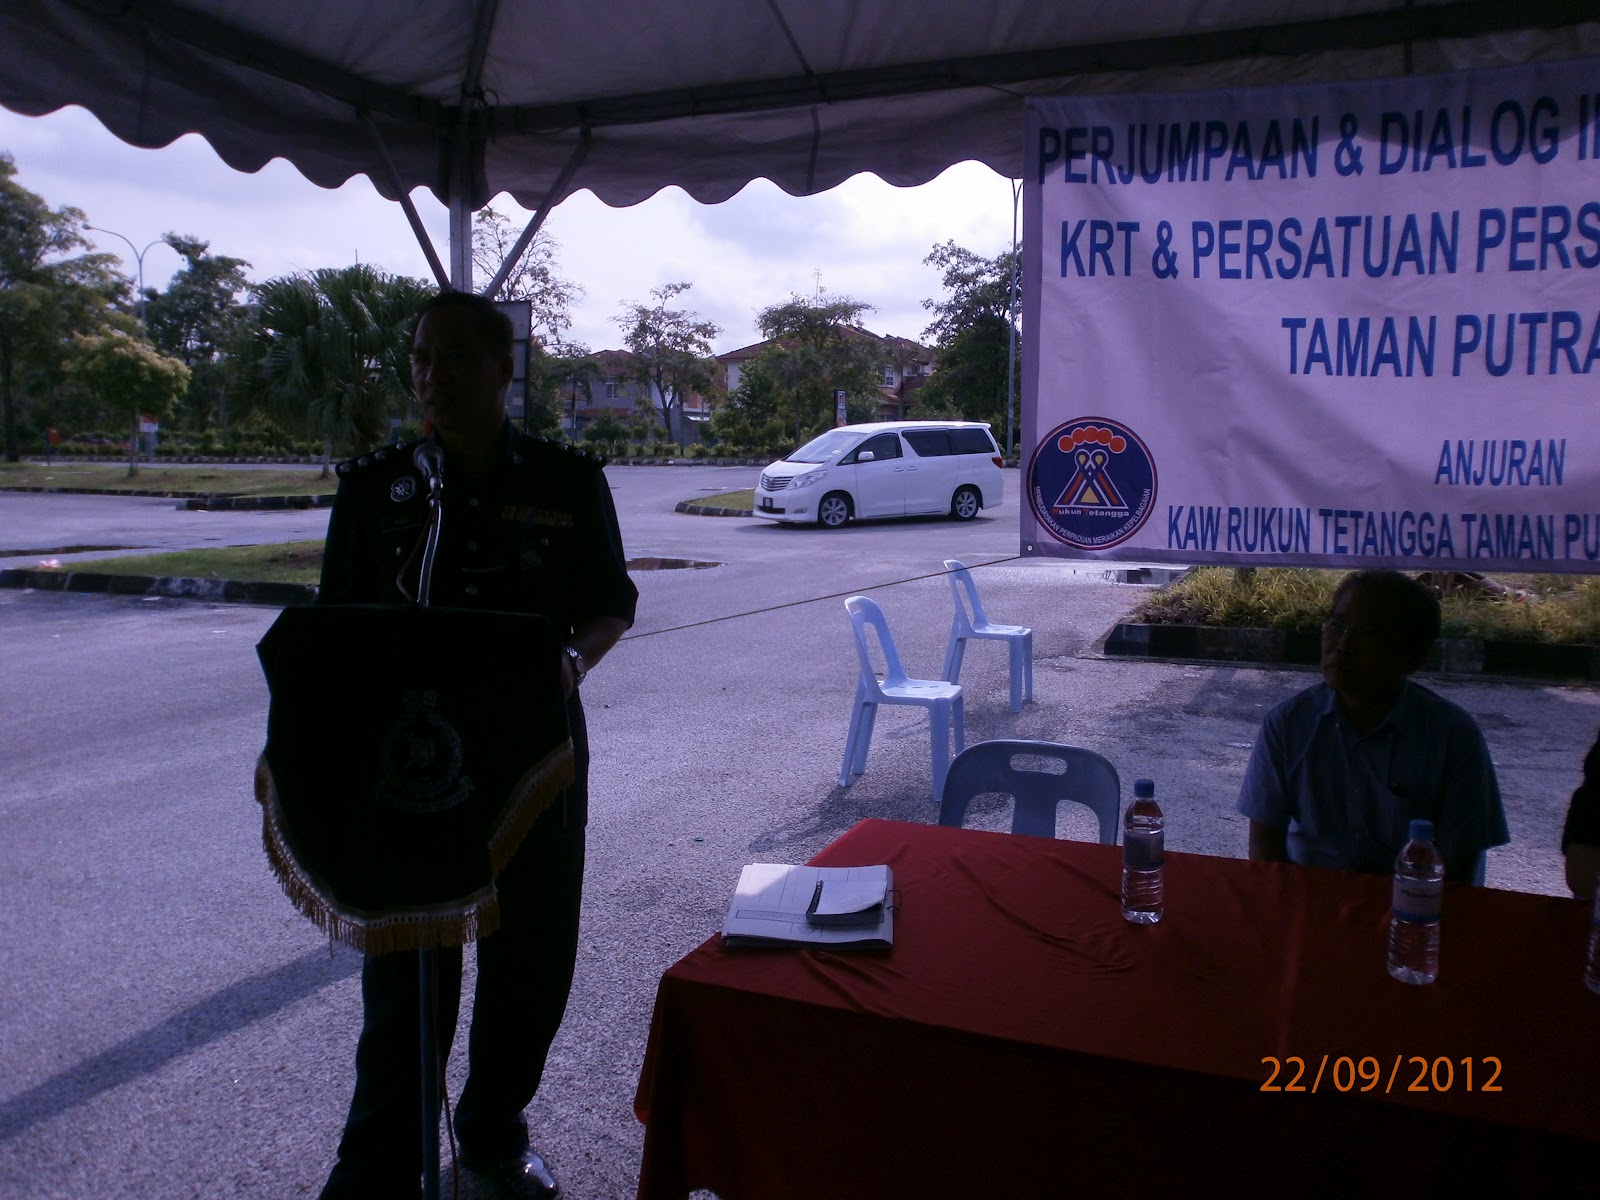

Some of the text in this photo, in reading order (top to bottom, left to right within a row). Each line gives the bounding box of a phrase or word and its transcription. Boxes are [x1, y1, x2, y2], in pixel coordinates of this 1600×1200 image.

[1038, 114, 1320, 185] PERJUMPAAN
[1334, 112, 1364, 177] &
[1379, 96, 1560, 174] DIALOG
[1061, 202, 1600, 280] KRT & PERSATUAN PERS
[1281, 315, 1437, 377] TAMAN
[1434, 439, 1567, 486] ANJURAN
[1034, 486, 1151, 544] MEMBUDAYAKAN PERPADUAN MERAIKAN KEPELBAGAIAN
[1085, 508, 1130, 518] Tetangga
[1168, 505, 1222, 551] KAW
[1227, 506, 1311, 554] RUKUN
[1319, 508, 1455, 557] TETANGGA
[1461, 514, 1554, 559] TAMAN
